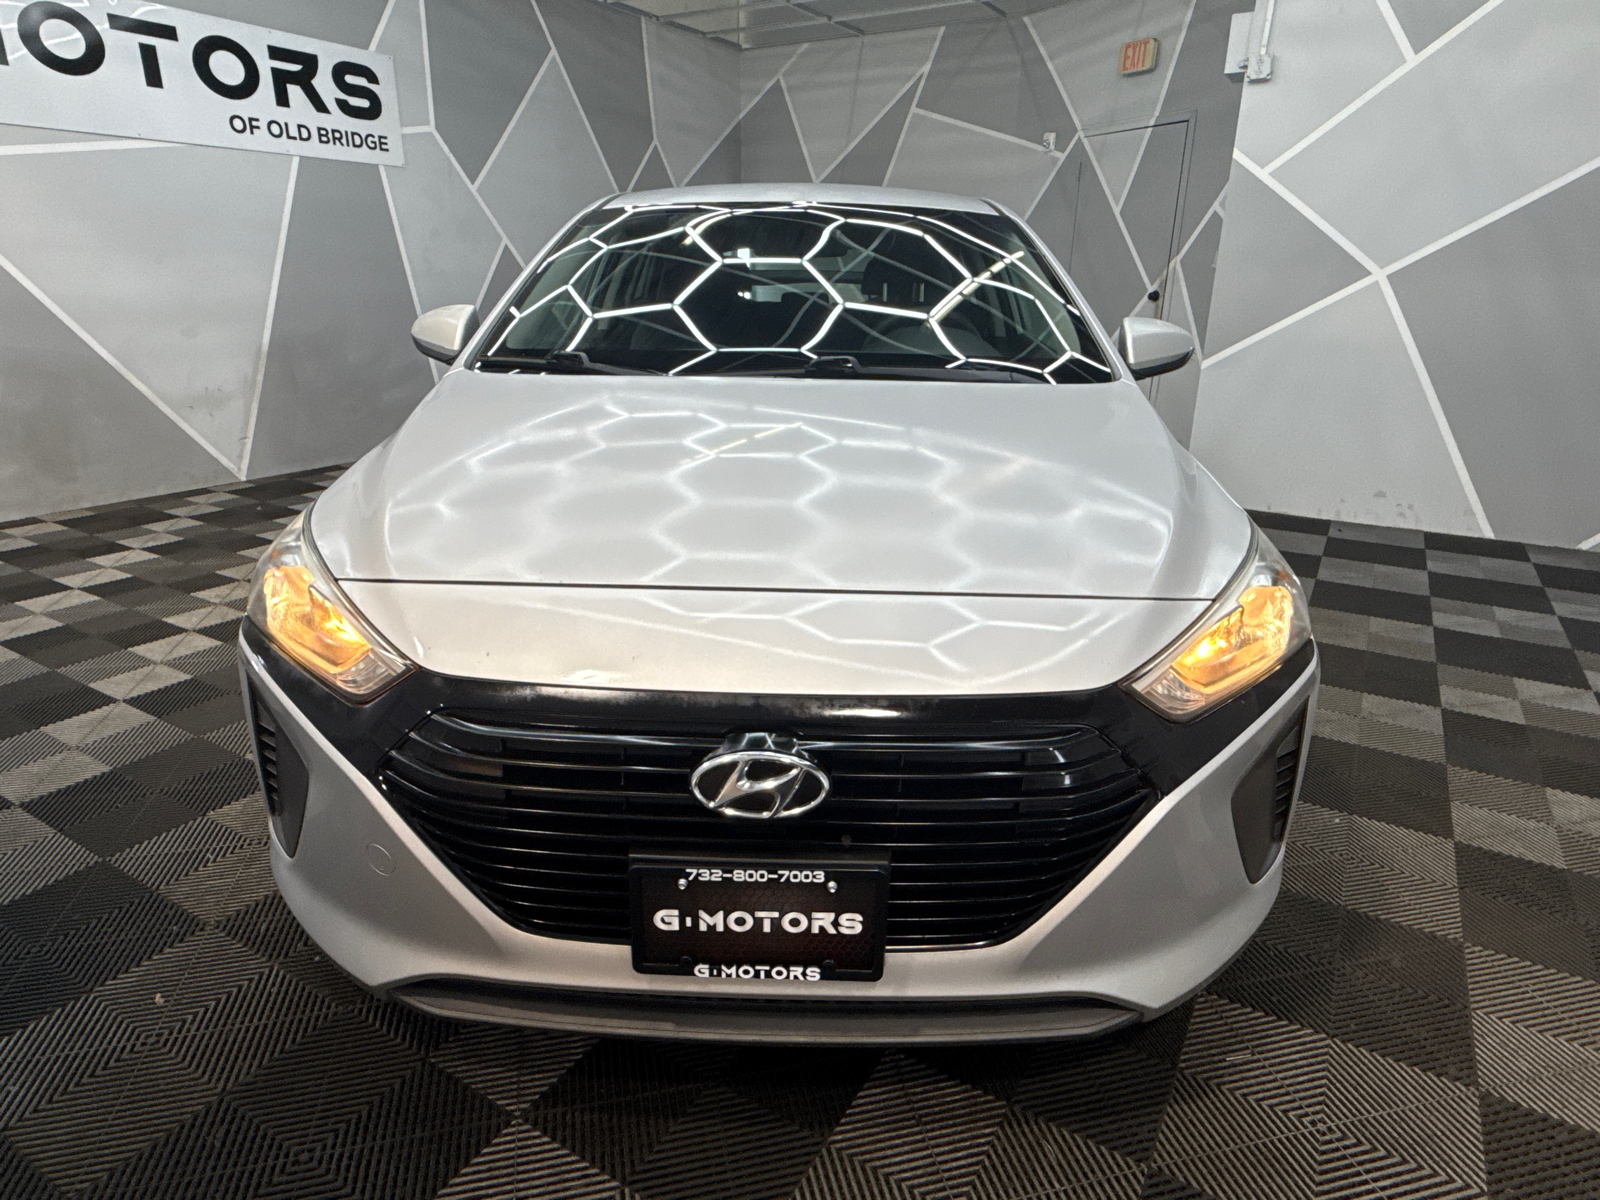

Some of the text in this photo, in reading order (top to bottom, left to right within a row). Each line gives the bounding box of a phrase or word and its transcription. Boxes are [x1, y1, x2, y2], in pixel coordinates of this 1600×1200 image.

[0, 0, 383, 121] OTORS
[1122, 40, 1150, 72] EXIT
[229, 114, 390, 152] OF OLD BRIDGE
[685, 868, 825, 883] 732-800-7003
